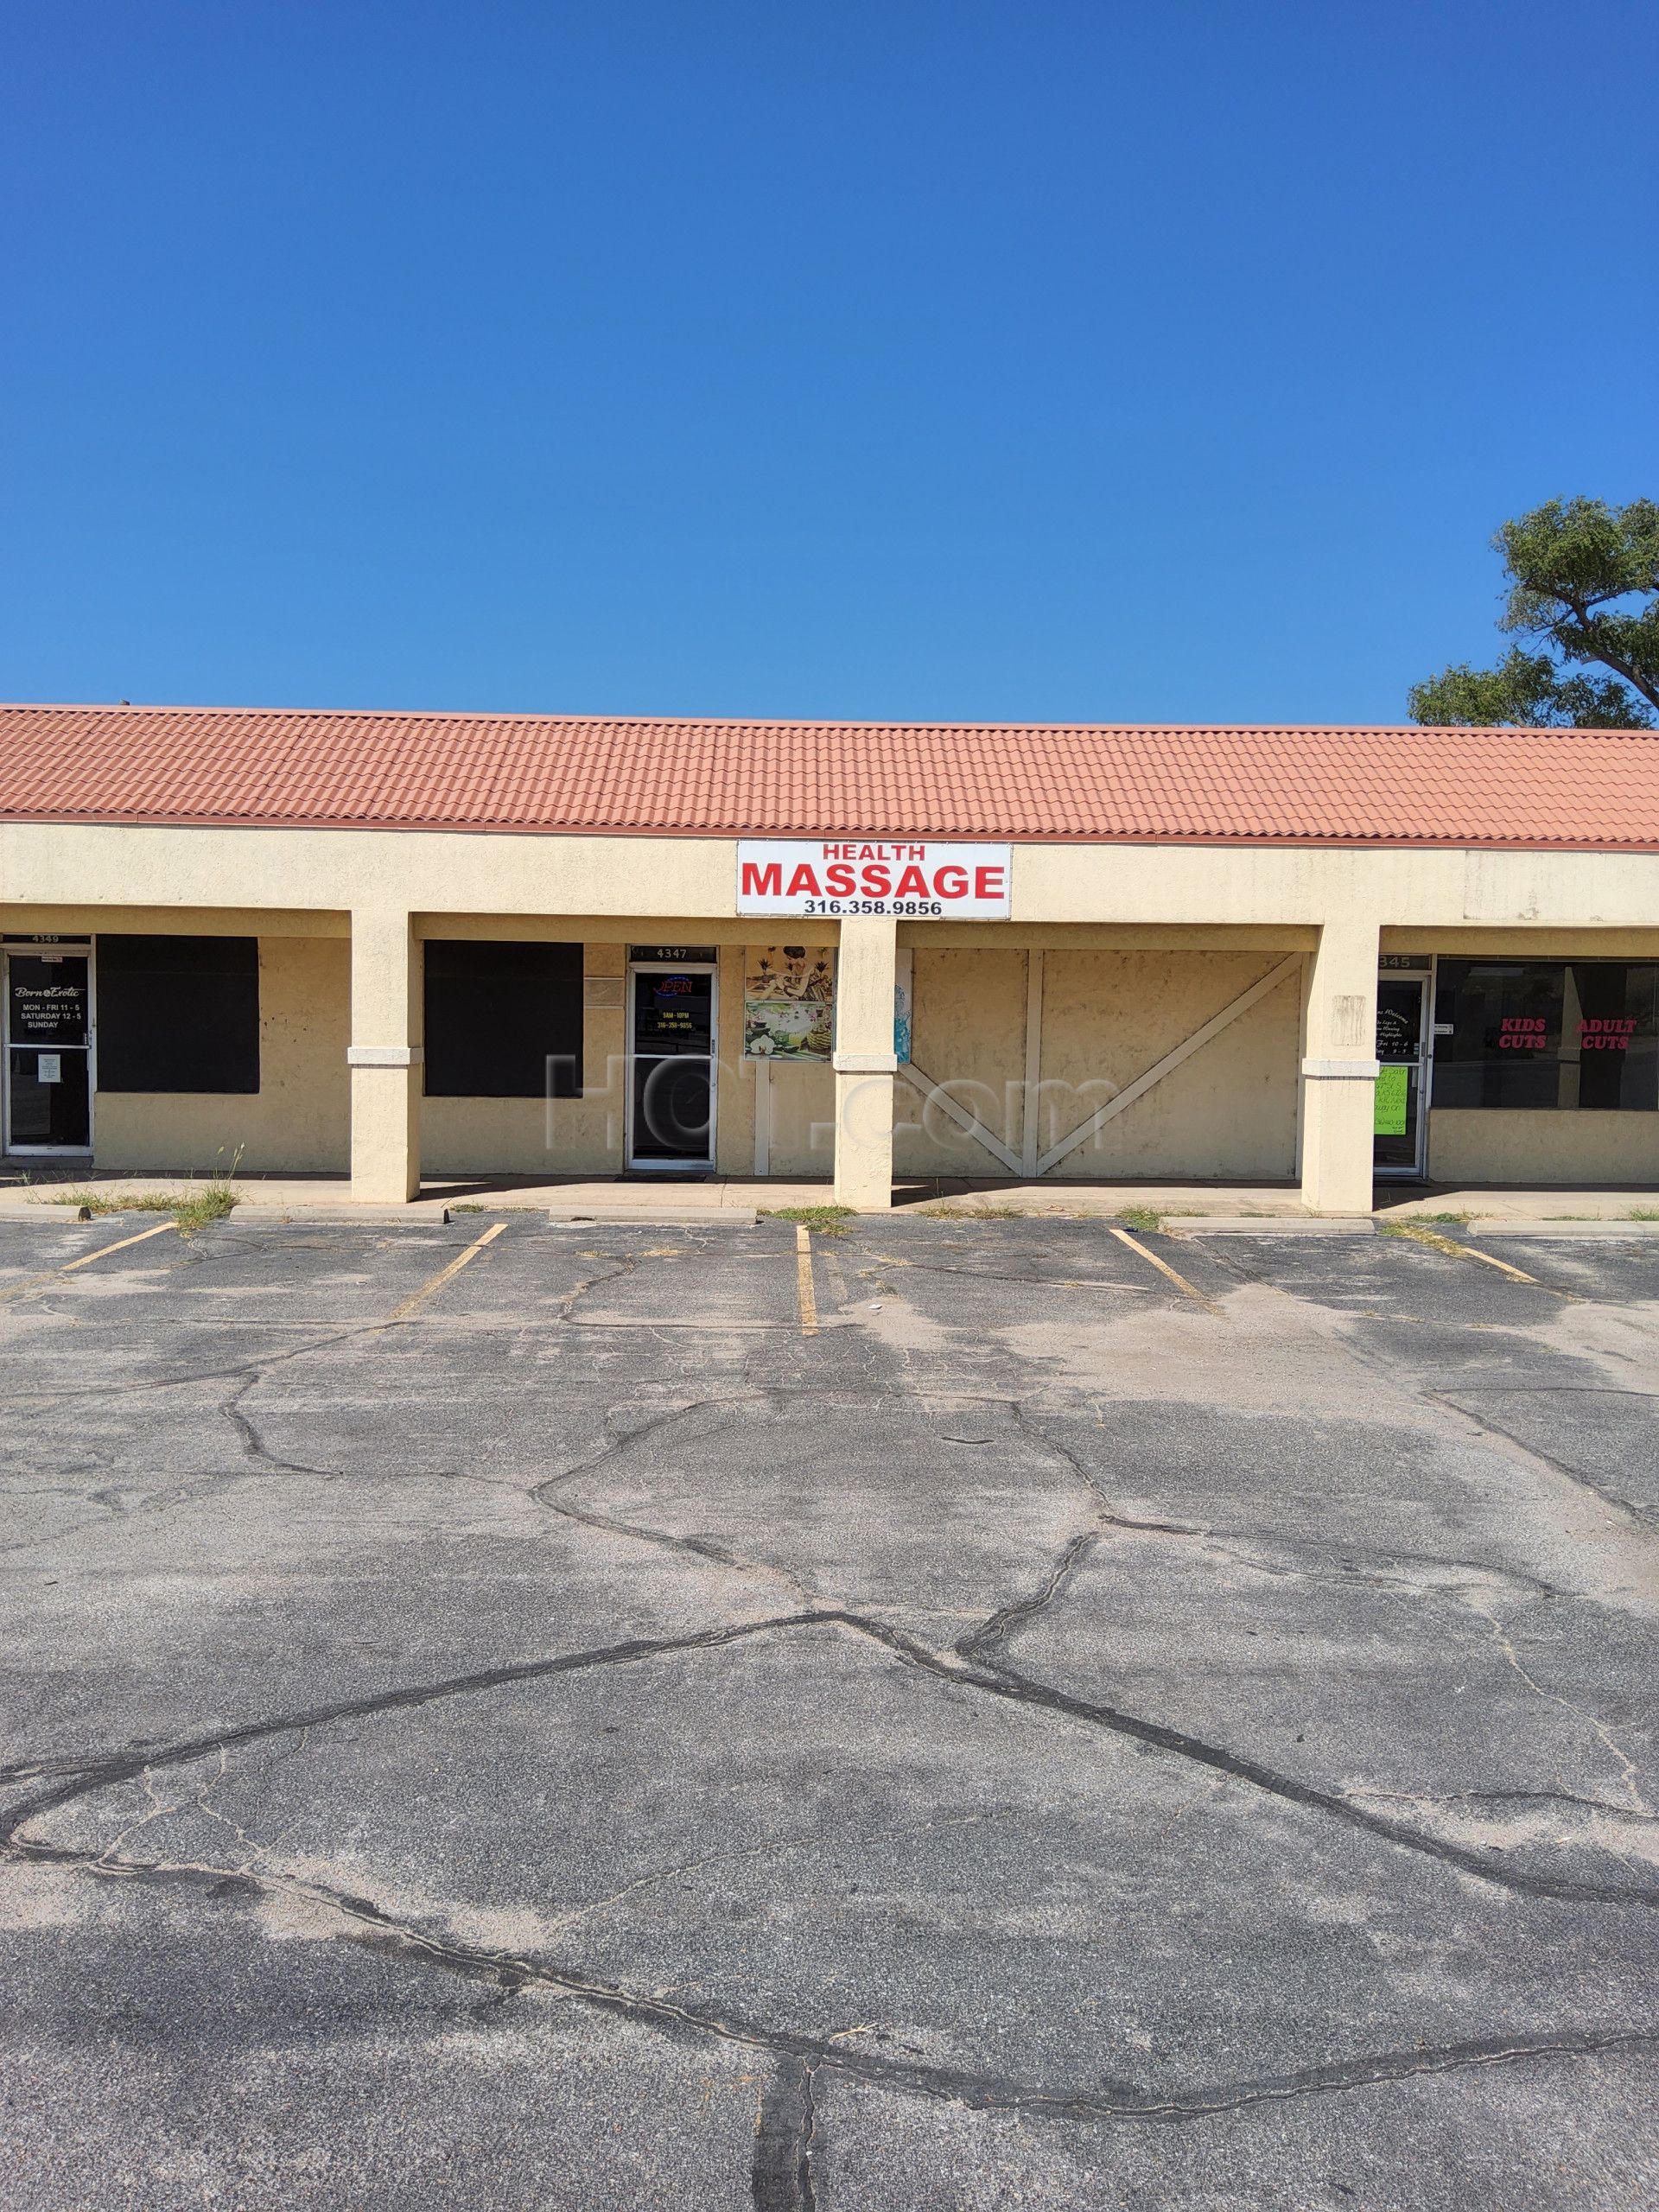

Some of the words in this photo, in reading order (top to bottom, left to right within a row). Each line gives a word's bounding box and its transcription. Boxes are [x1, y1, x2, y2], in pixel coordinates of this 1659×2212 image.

[823, 843, 925, 861] HEALTH
[741, 862, 1005, 899] MASSAGE
[804, 899, 943, 915] 316.358.9856
[657, 948, 687, 958] 4347
[1378, 956, 1411, 968] 345
[15, 987, 44, 997] Born
[50, 987, 86, 997] Exotic
[1501, 1018, 1546, 1032] KIDS
[1576, 1020, 1637, 1033] ADULT
[1499, 1035, 1547, 1048] CUTS
[1581, 1036, 1630, 1049] CUTS
